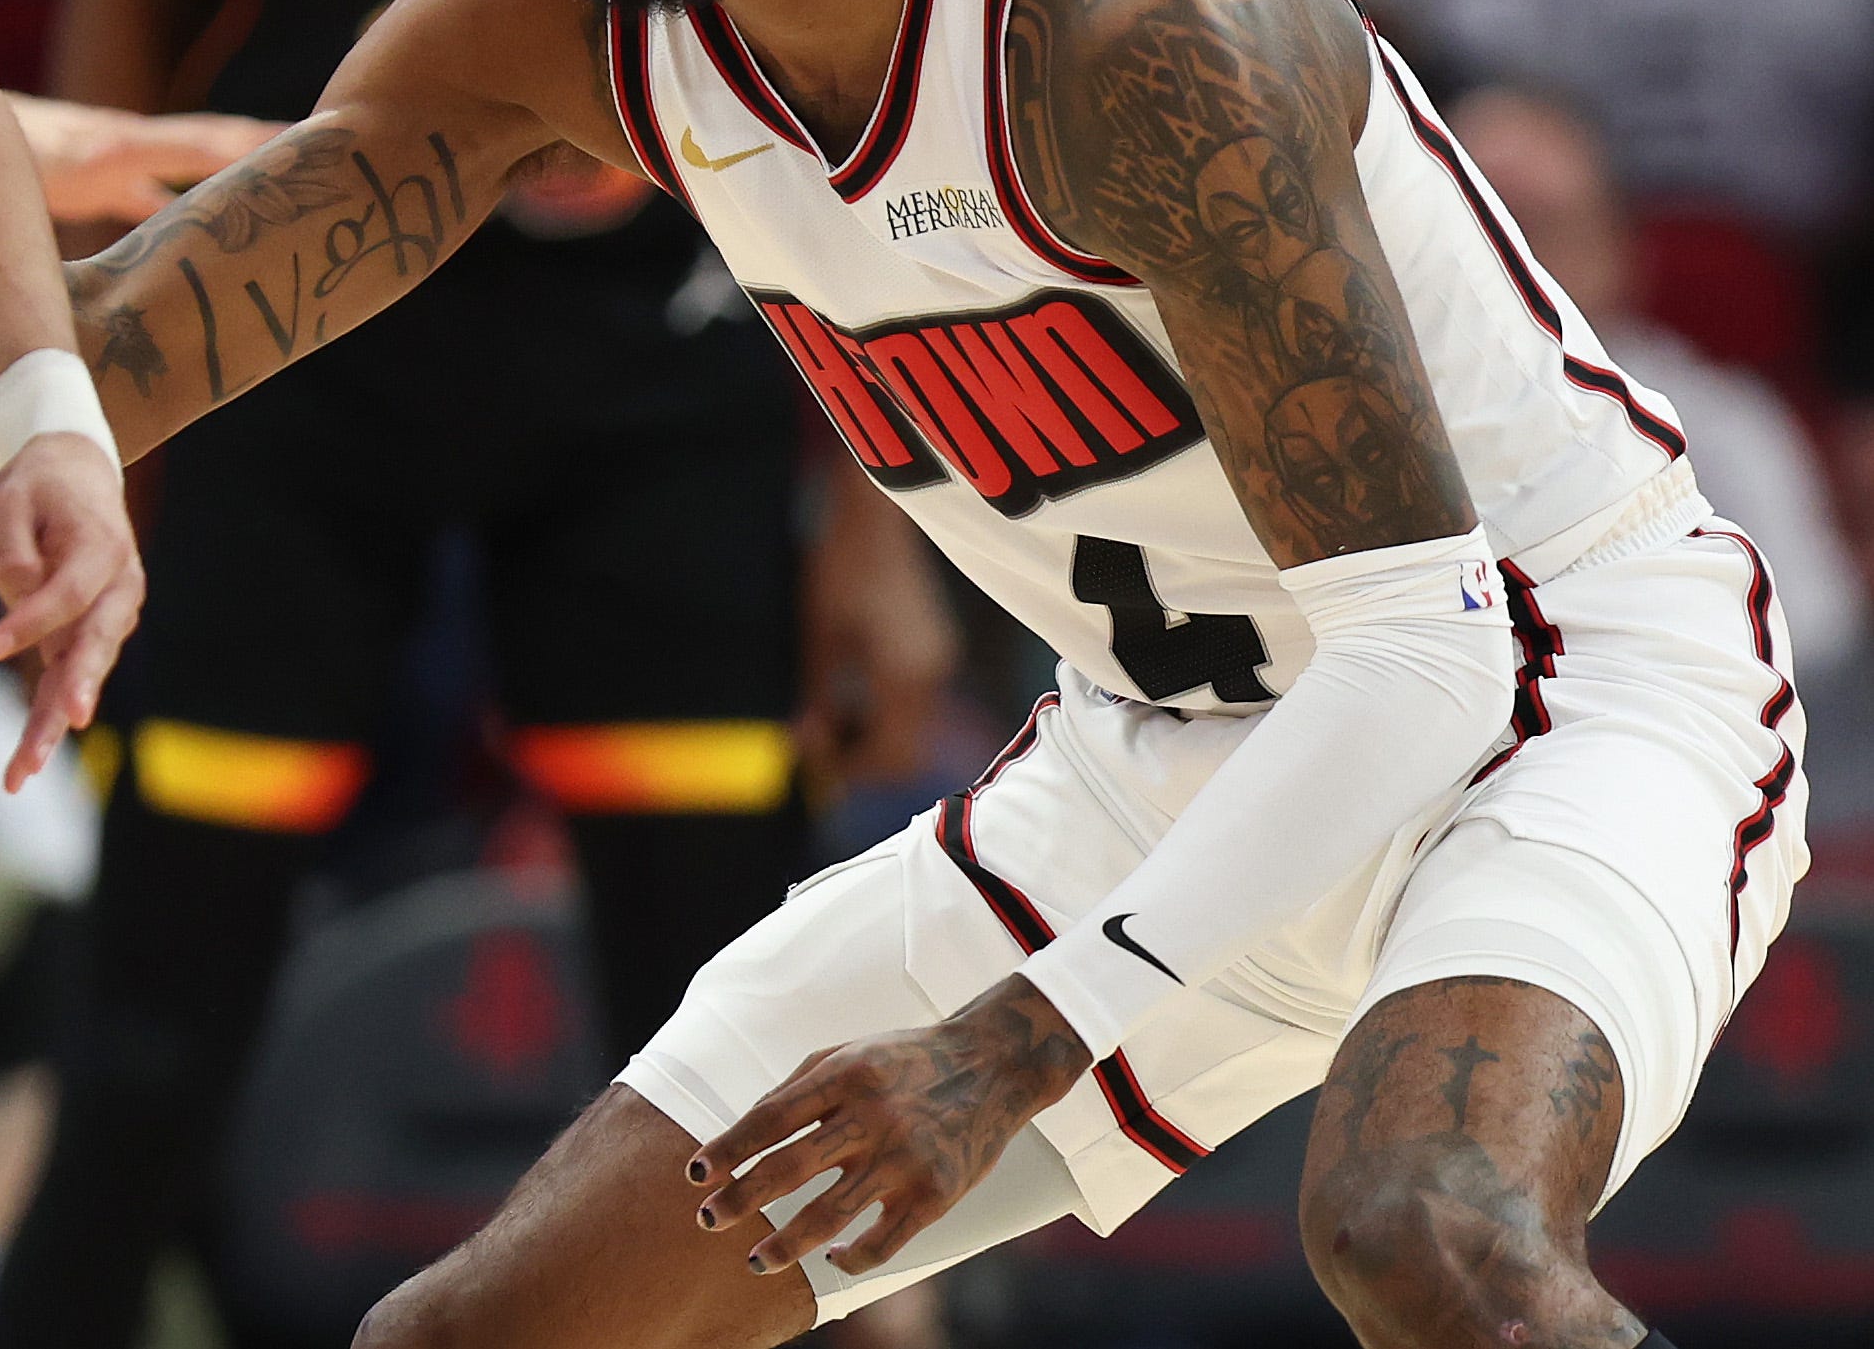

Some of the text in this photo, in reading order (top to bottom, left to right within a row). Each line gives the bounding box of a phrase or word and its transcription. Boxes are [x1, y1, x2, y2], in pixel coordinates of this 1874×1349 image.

[886, 187, 999, 222] MEMORIAL
[887, 208, 1004, 240] HERMANN
[750, 293, 1192, 508] H-OWN
[1068, 533, 1284, 705] 4
